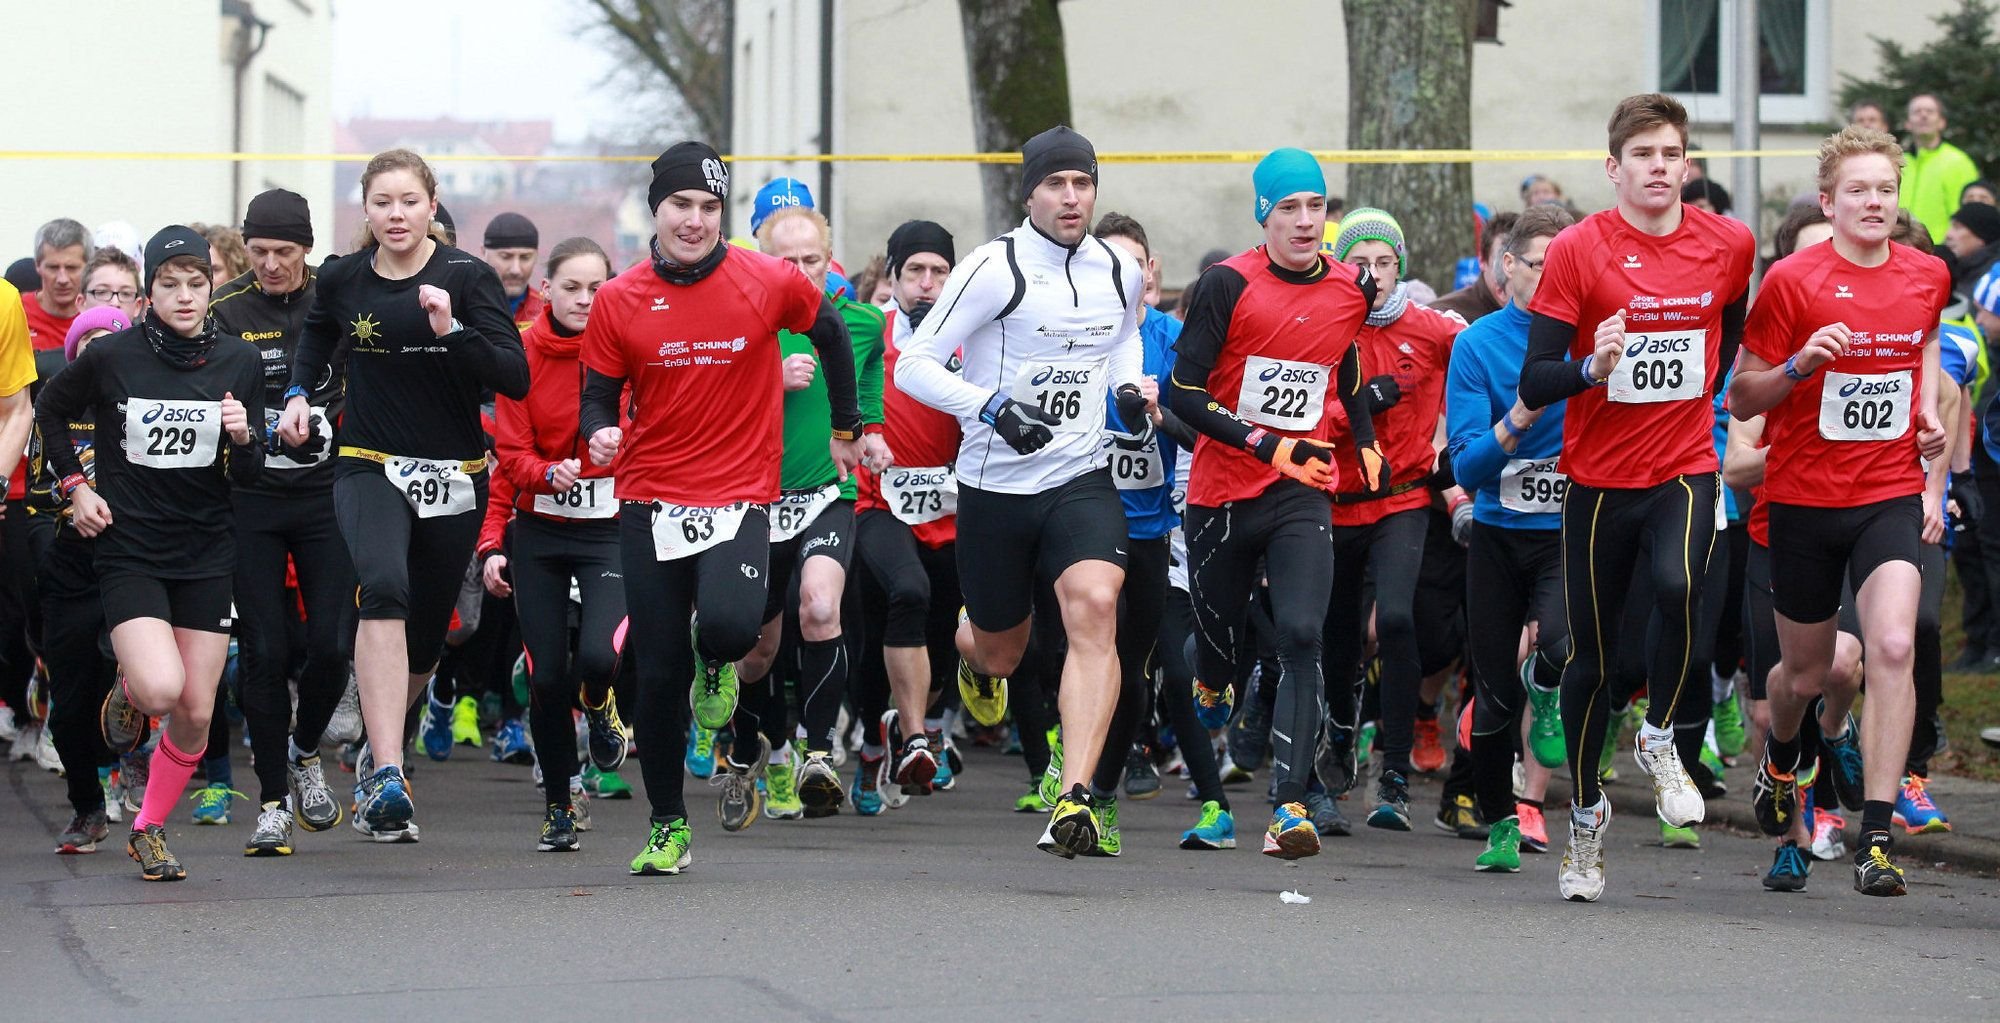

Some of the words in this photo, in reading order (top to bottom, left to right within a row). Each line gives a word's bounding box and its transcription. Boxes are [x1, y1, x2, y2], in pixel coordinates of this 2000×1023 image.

[771, 190, 801, 208] DNB
[1662, 297, 1700, 306] SCHUNK
[1632, 313, 1659, 321] EnBW
[660, 341, 687, 349] SPORT
[692, 341, 732, 350] SCHUNK
[1648, 338, 1691, 353] asics
[1875, 334, 1912, 342] SCHUNK
[664, 357, 691, 367] EnBW
[1052, 370, 1091, 384] asics
[1280, 368, 1319, 384] asics
[1632, 359, 1684, 390] 603
[1861, 379, 1901, 395] asics
[1036, 390, 1082, 420] 166
[1260, 386, 1309, 418] 222
[163, 408, 206, 422] asics
[1843, 400, 1894, 429] 602
[69, 423, 96, 431] ONSO
[147, 427, 197, 456] 229
[1106, 454, 1149, 480] 103
[1535, 462, 1558, 473] asi
[910, 472, 946, 486] asics
[1520, 476, 1566, 504] 599
[900, 490, 942, 514] 273
[681, 515, 715, 543] 63
